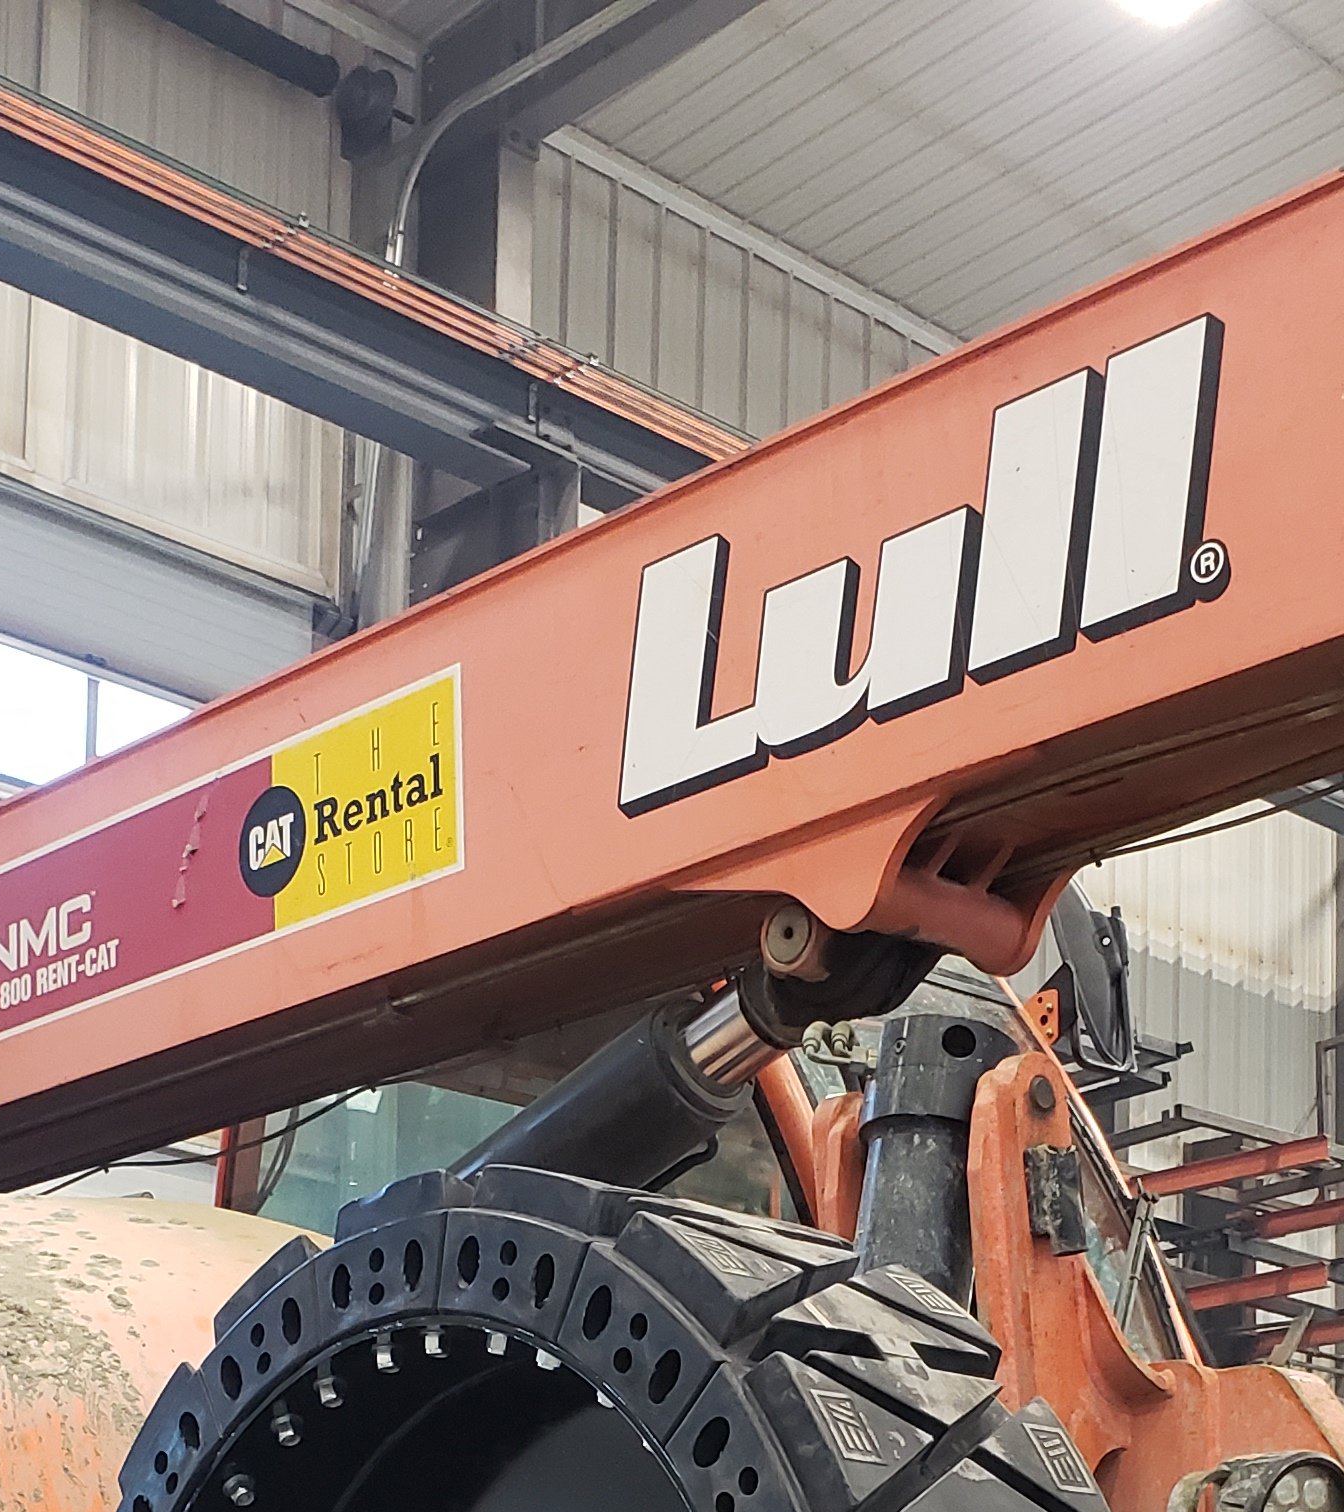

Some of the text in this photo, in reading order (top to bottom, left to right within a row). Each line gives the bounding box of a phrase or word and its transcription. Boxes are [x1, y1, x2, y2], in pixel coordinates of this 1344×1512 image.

[313, 753, 443, 845] Rental
[248, 812, 295, 871] CAT
[0, 974, 32, 1010] 800
[36, 938, 120, 996] RENT-CAT
